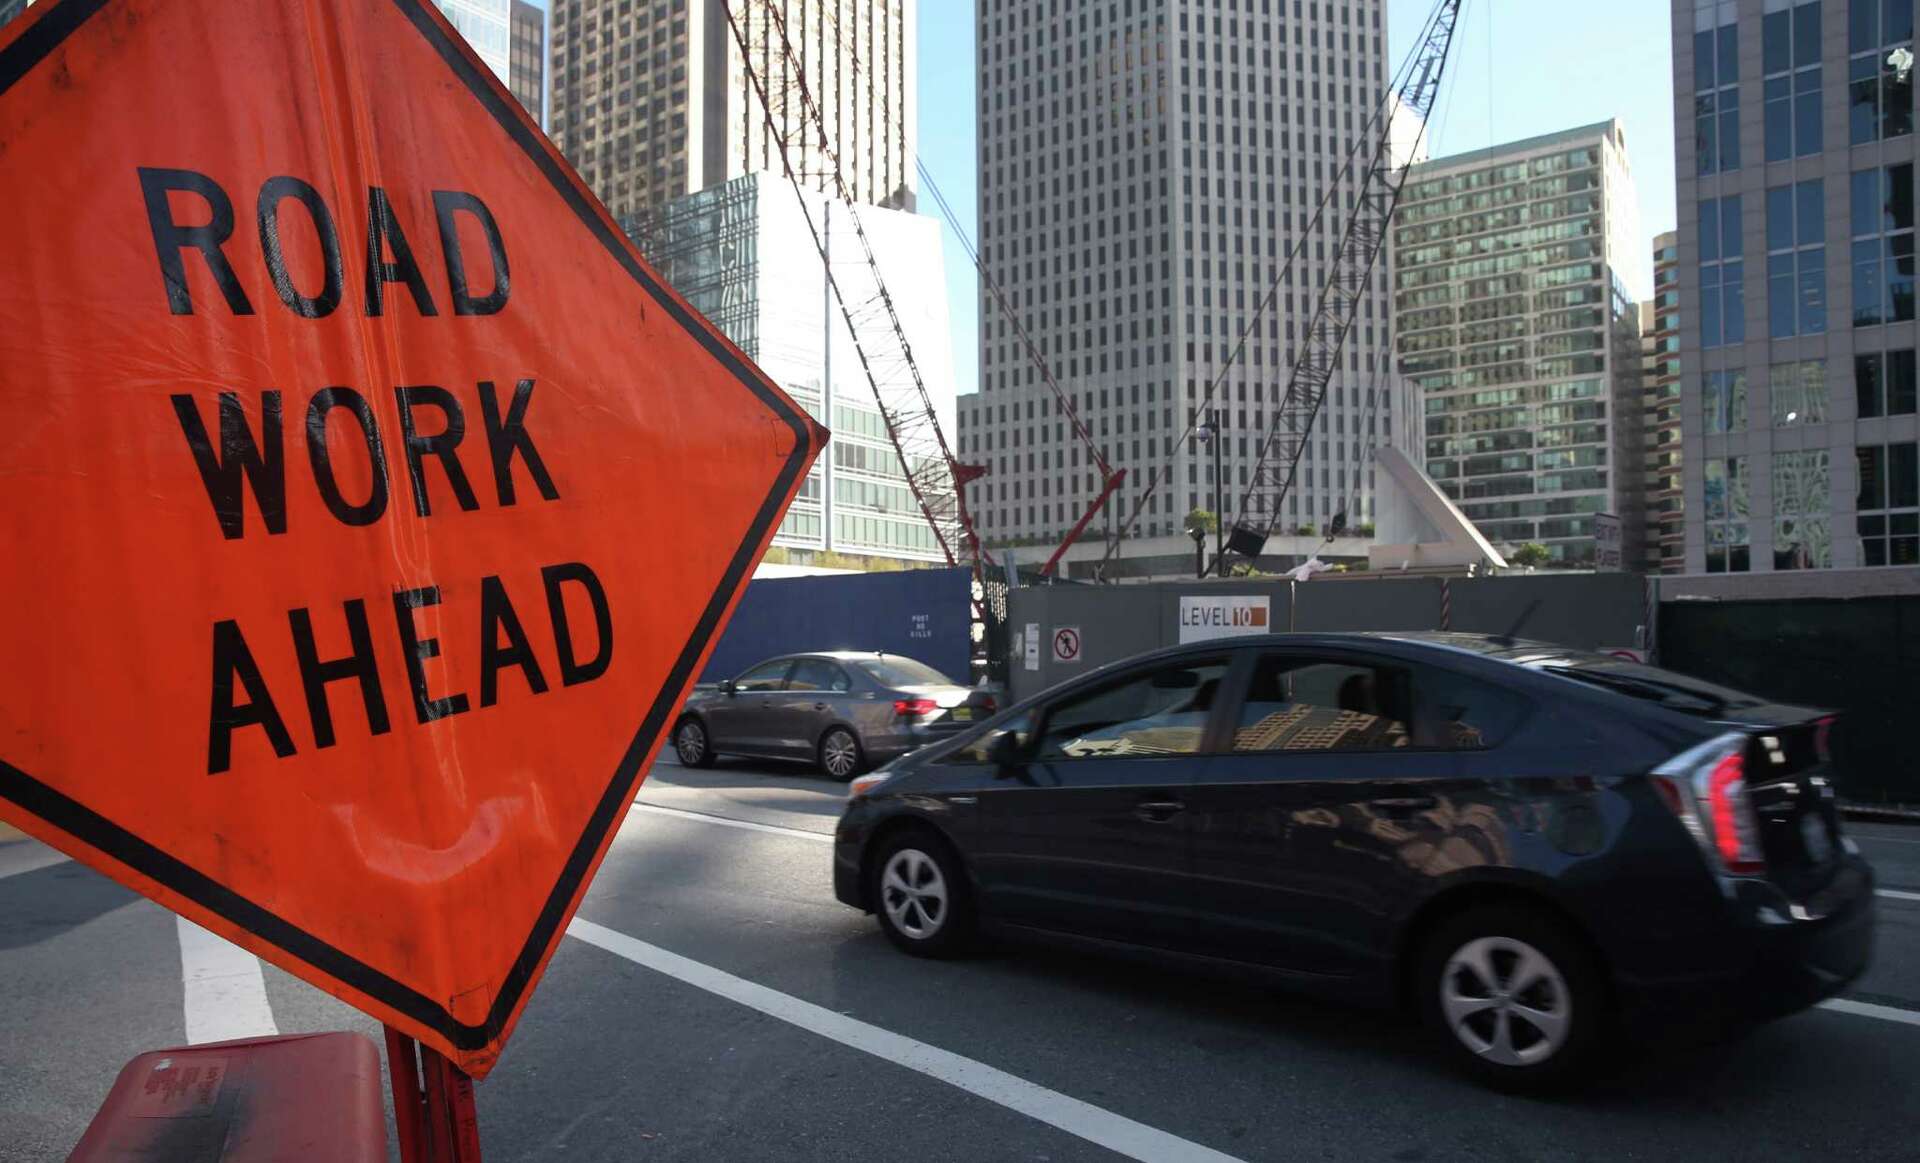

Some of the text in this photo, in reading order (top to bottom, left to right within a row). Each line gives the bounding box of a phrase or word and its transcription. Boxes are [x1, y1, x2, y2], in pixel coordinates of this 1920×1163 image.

[137, 167, 511, 318] ROAD
[170, 379, 561, 540] WORK
[208, 562, 614, 776] AHEAD
